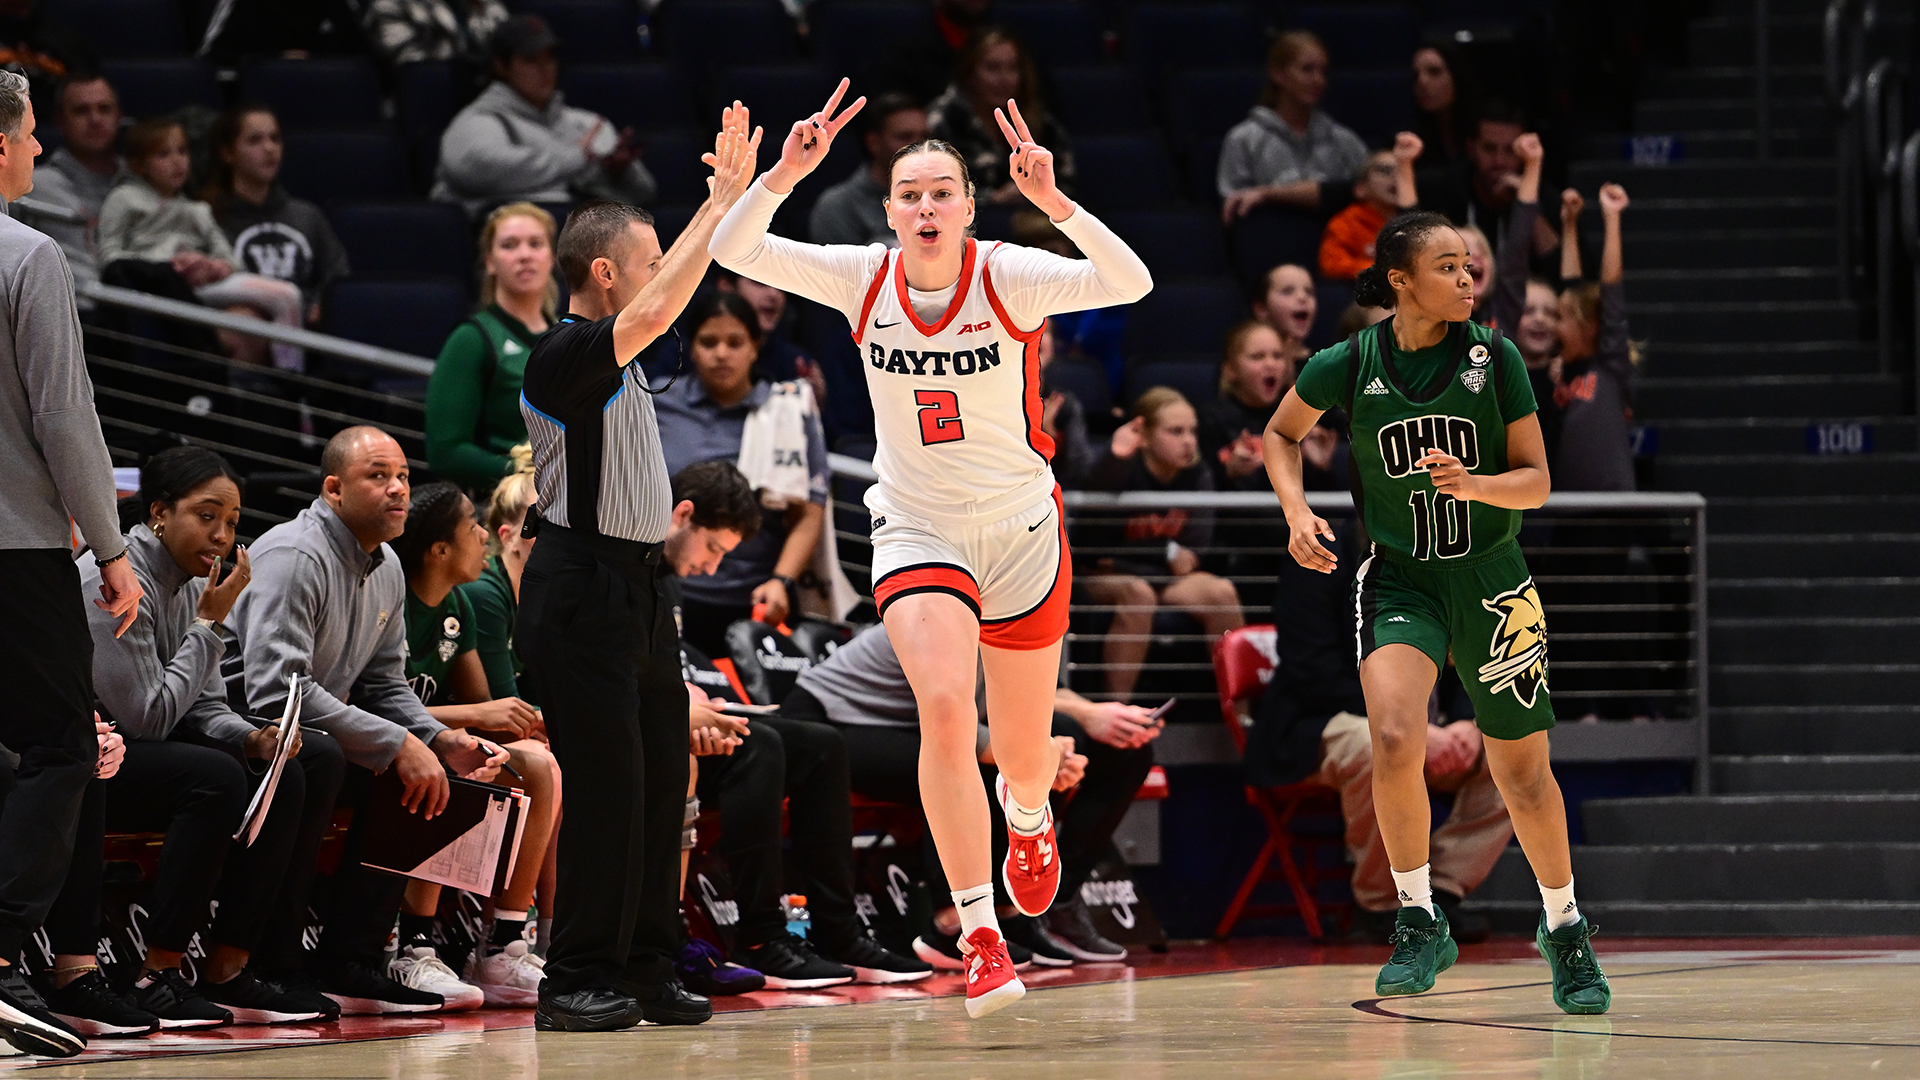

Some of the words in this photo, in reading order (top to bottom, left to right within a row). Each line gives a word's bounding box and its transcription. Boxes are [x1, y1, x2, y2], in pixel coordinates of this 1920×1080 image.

[957, 320, 992, 336] A10
[869, 341, 1001, 376] DAYTON
[1363, 388, 1390, 396] adidas
[913, 389, 966, 447] 2
[1377, 414, 1480, 479] OHIO
[1408, 489, 1472, 562] 10
